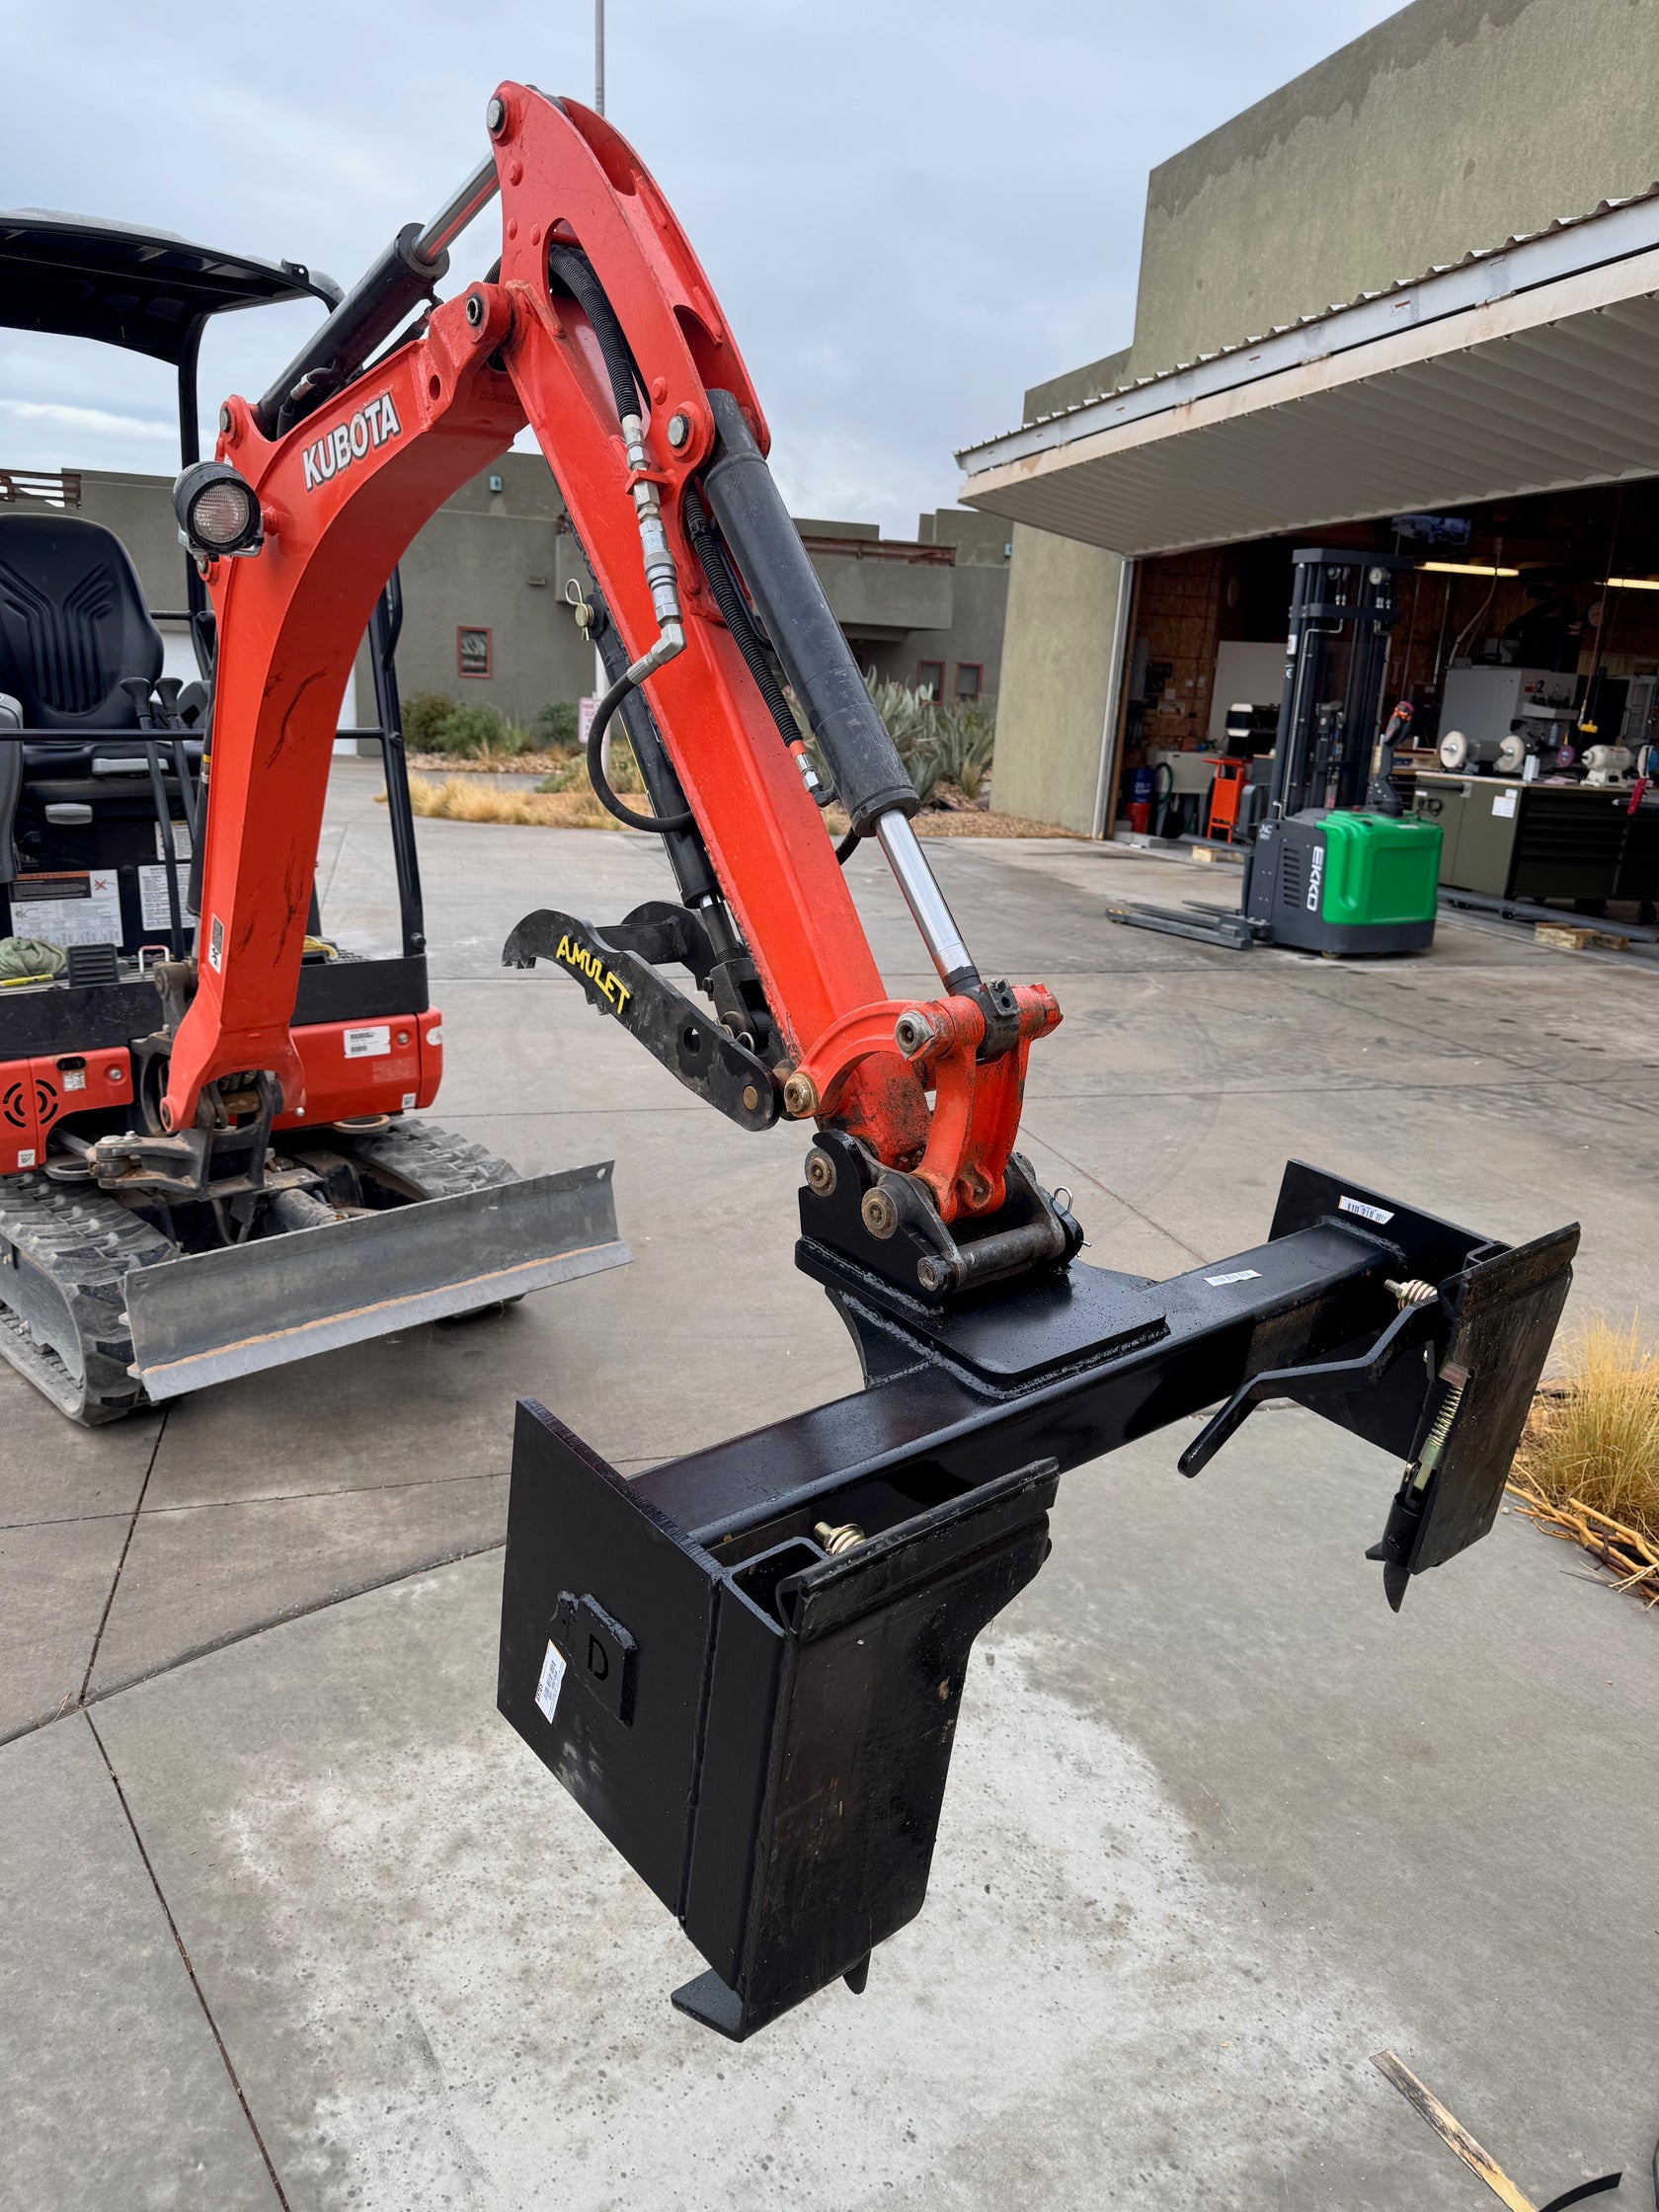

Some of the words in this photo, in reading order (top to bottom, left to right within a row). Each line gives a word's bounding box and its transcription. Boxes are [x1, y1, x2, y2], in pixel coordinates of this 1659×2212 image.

[302, 392, 401, 492] KUBOTA
[1306, 845, 1324, 911] EKKO
[556, 934, 631, 1015] AMULET
